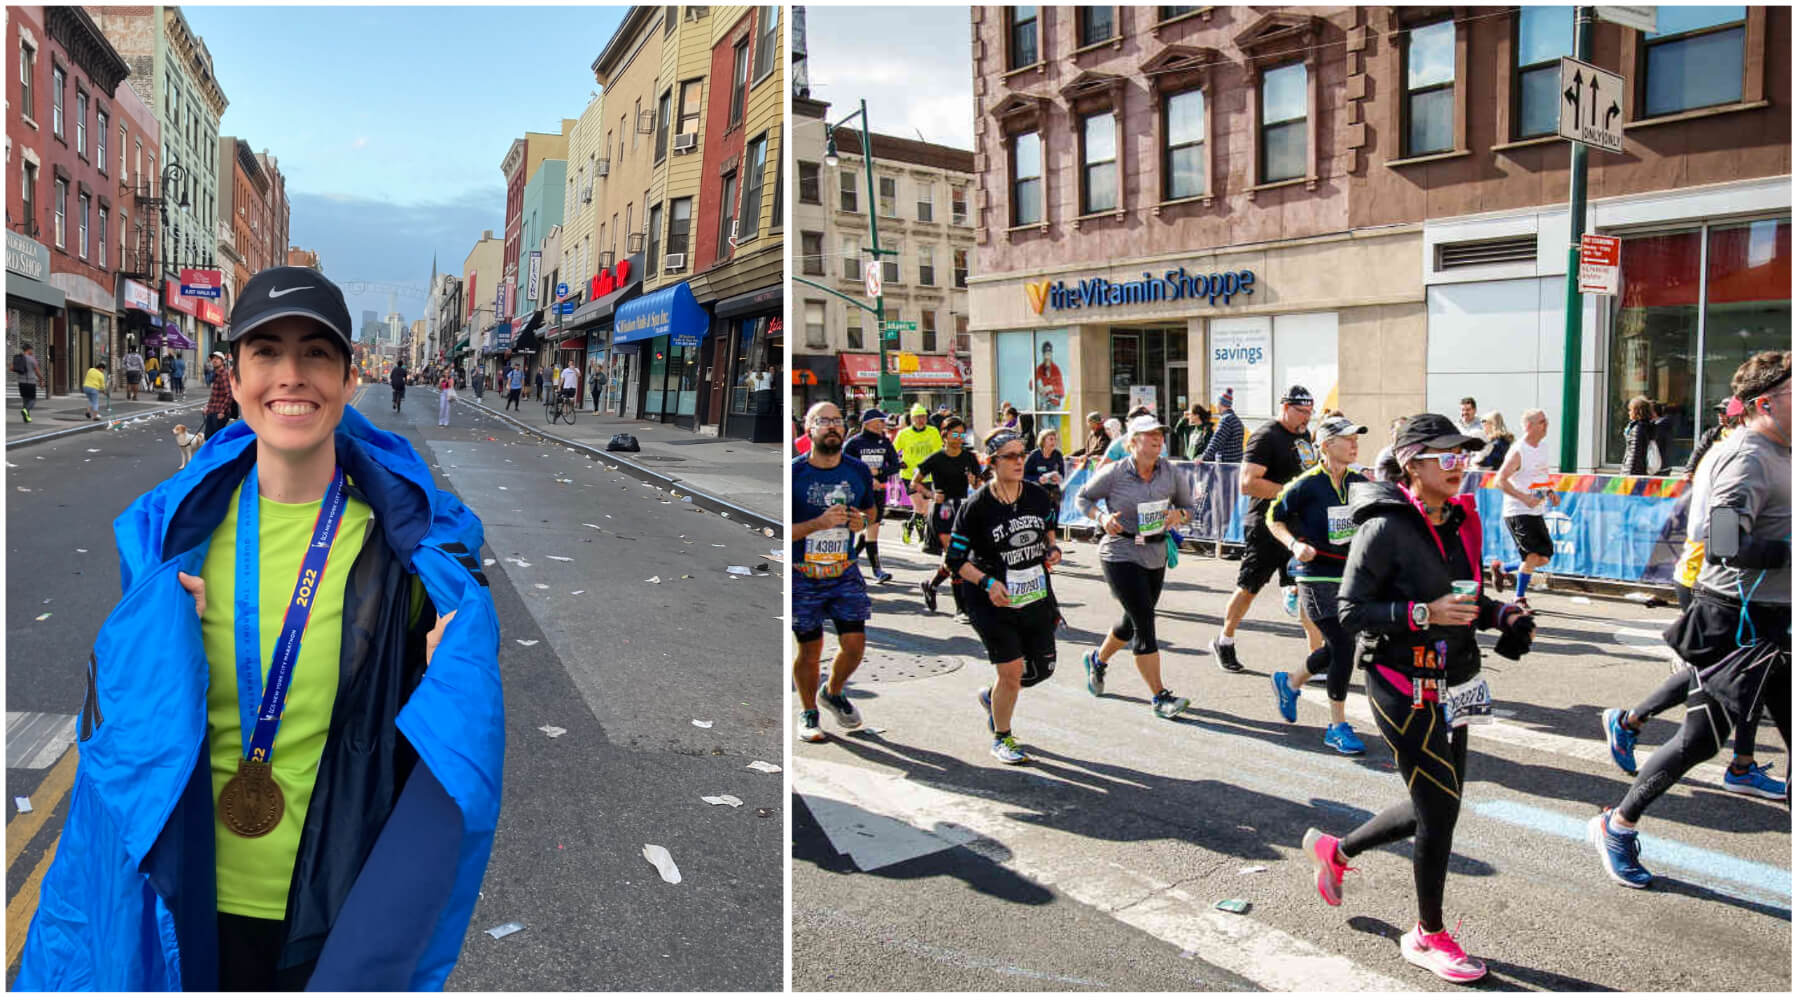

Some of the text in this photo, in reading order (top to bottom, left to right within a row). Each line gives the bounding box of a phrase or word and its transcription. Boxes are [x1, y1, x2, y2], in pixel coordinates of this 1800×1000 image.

[1583, 126, 1601, 142] ONLY
[1604, 131, 1620, 147] ONLY
[20, 253, 42, 277] SHOP
[1215, 344, 1263, 365] savings
[296, 568, 318, 608] 2022
